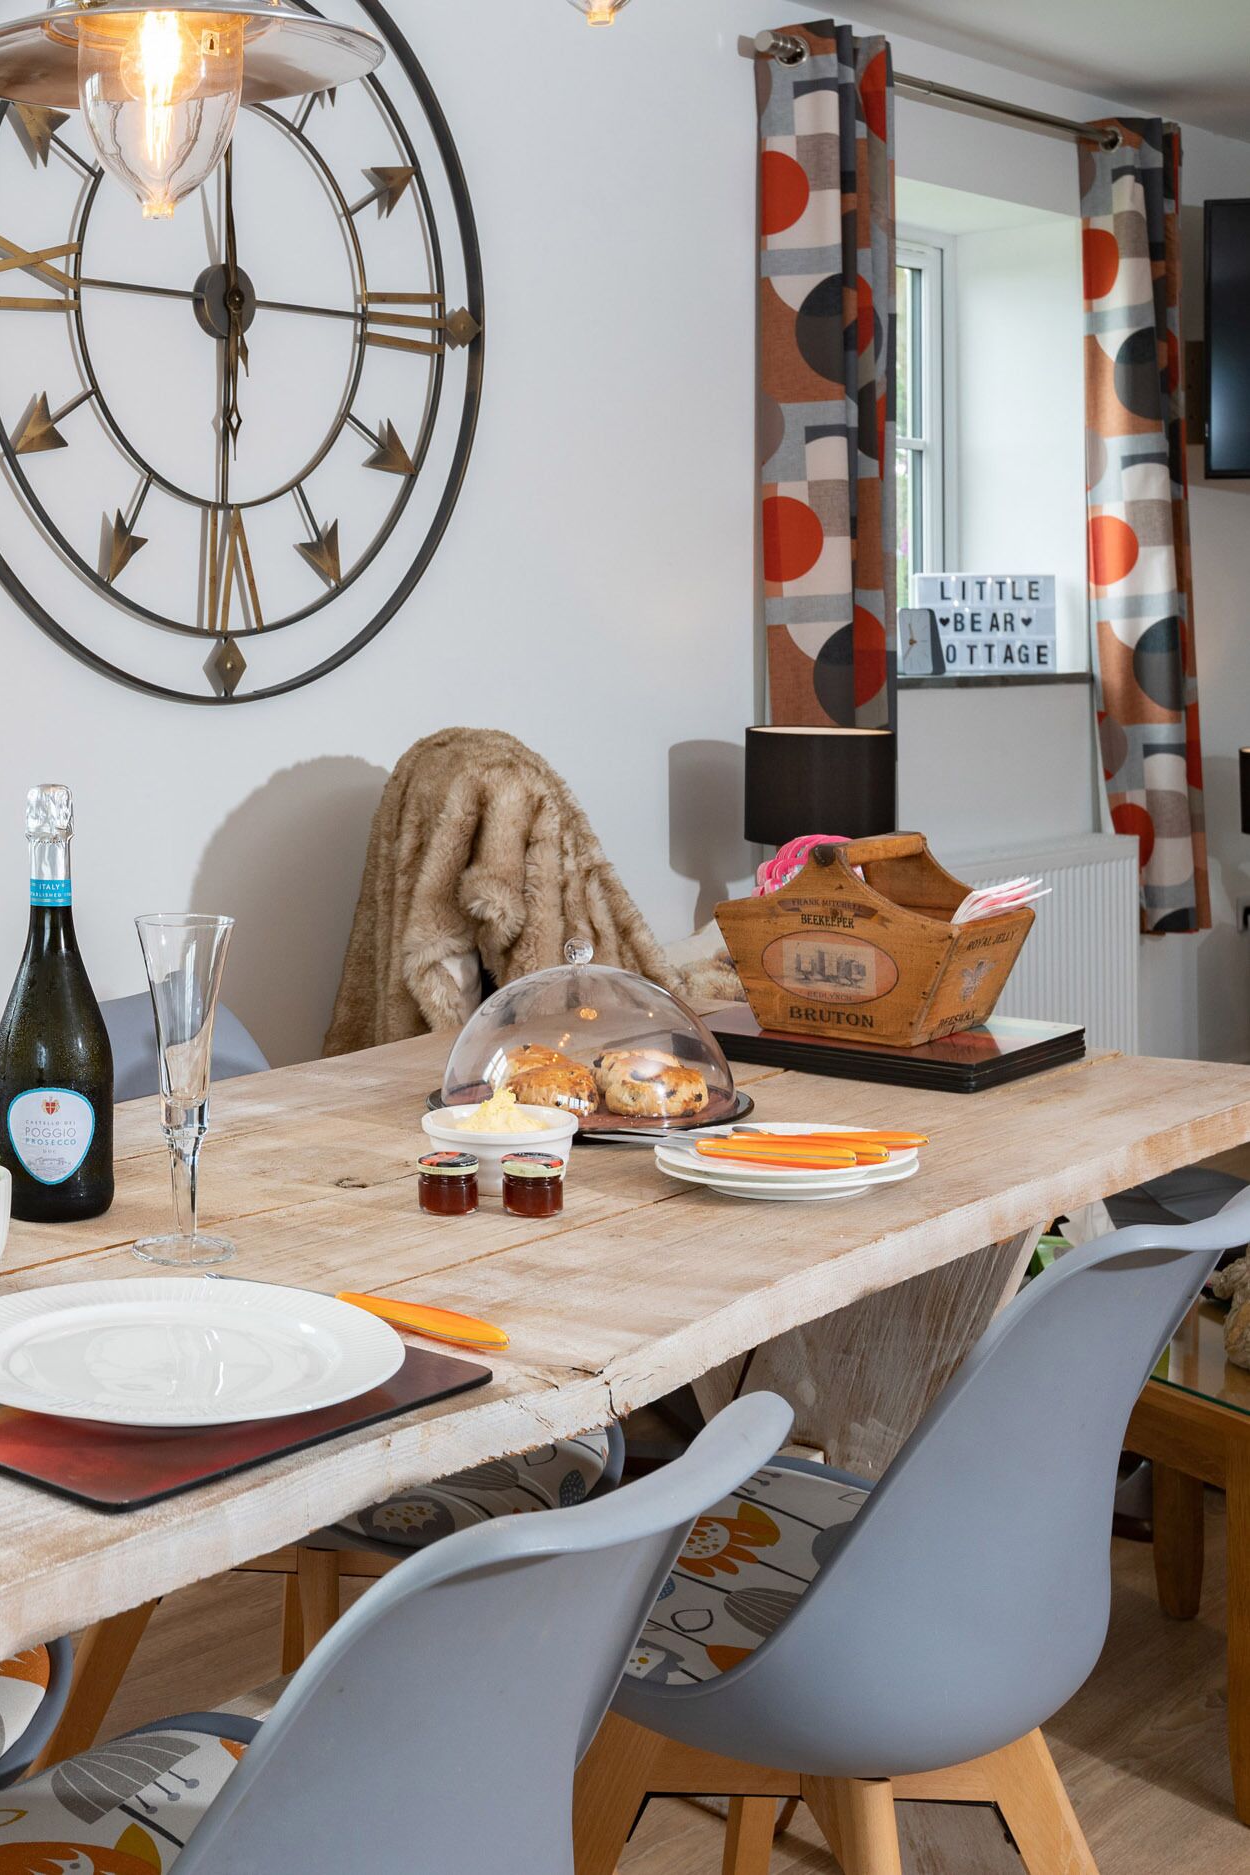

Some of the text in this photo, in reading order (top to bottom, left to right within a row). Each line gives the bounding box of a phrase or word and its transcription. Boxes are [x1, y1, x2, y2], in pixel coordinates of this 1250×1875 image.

[940, 581, 1040, 601] LITTLE
[953, 612, 1015, 633] BEAR
[945, 644, 1049, 665] OTTAGE
[800, 913, 855, 929] BEEKEEPER
[966, 928, 1018, 952] ROYAL JELLY
[789, 1006, 874, 1028] BRUTON
[25, 1126, 77, 1138] POGGIO
[25, 1138, 77, 1146] PROSECCO
